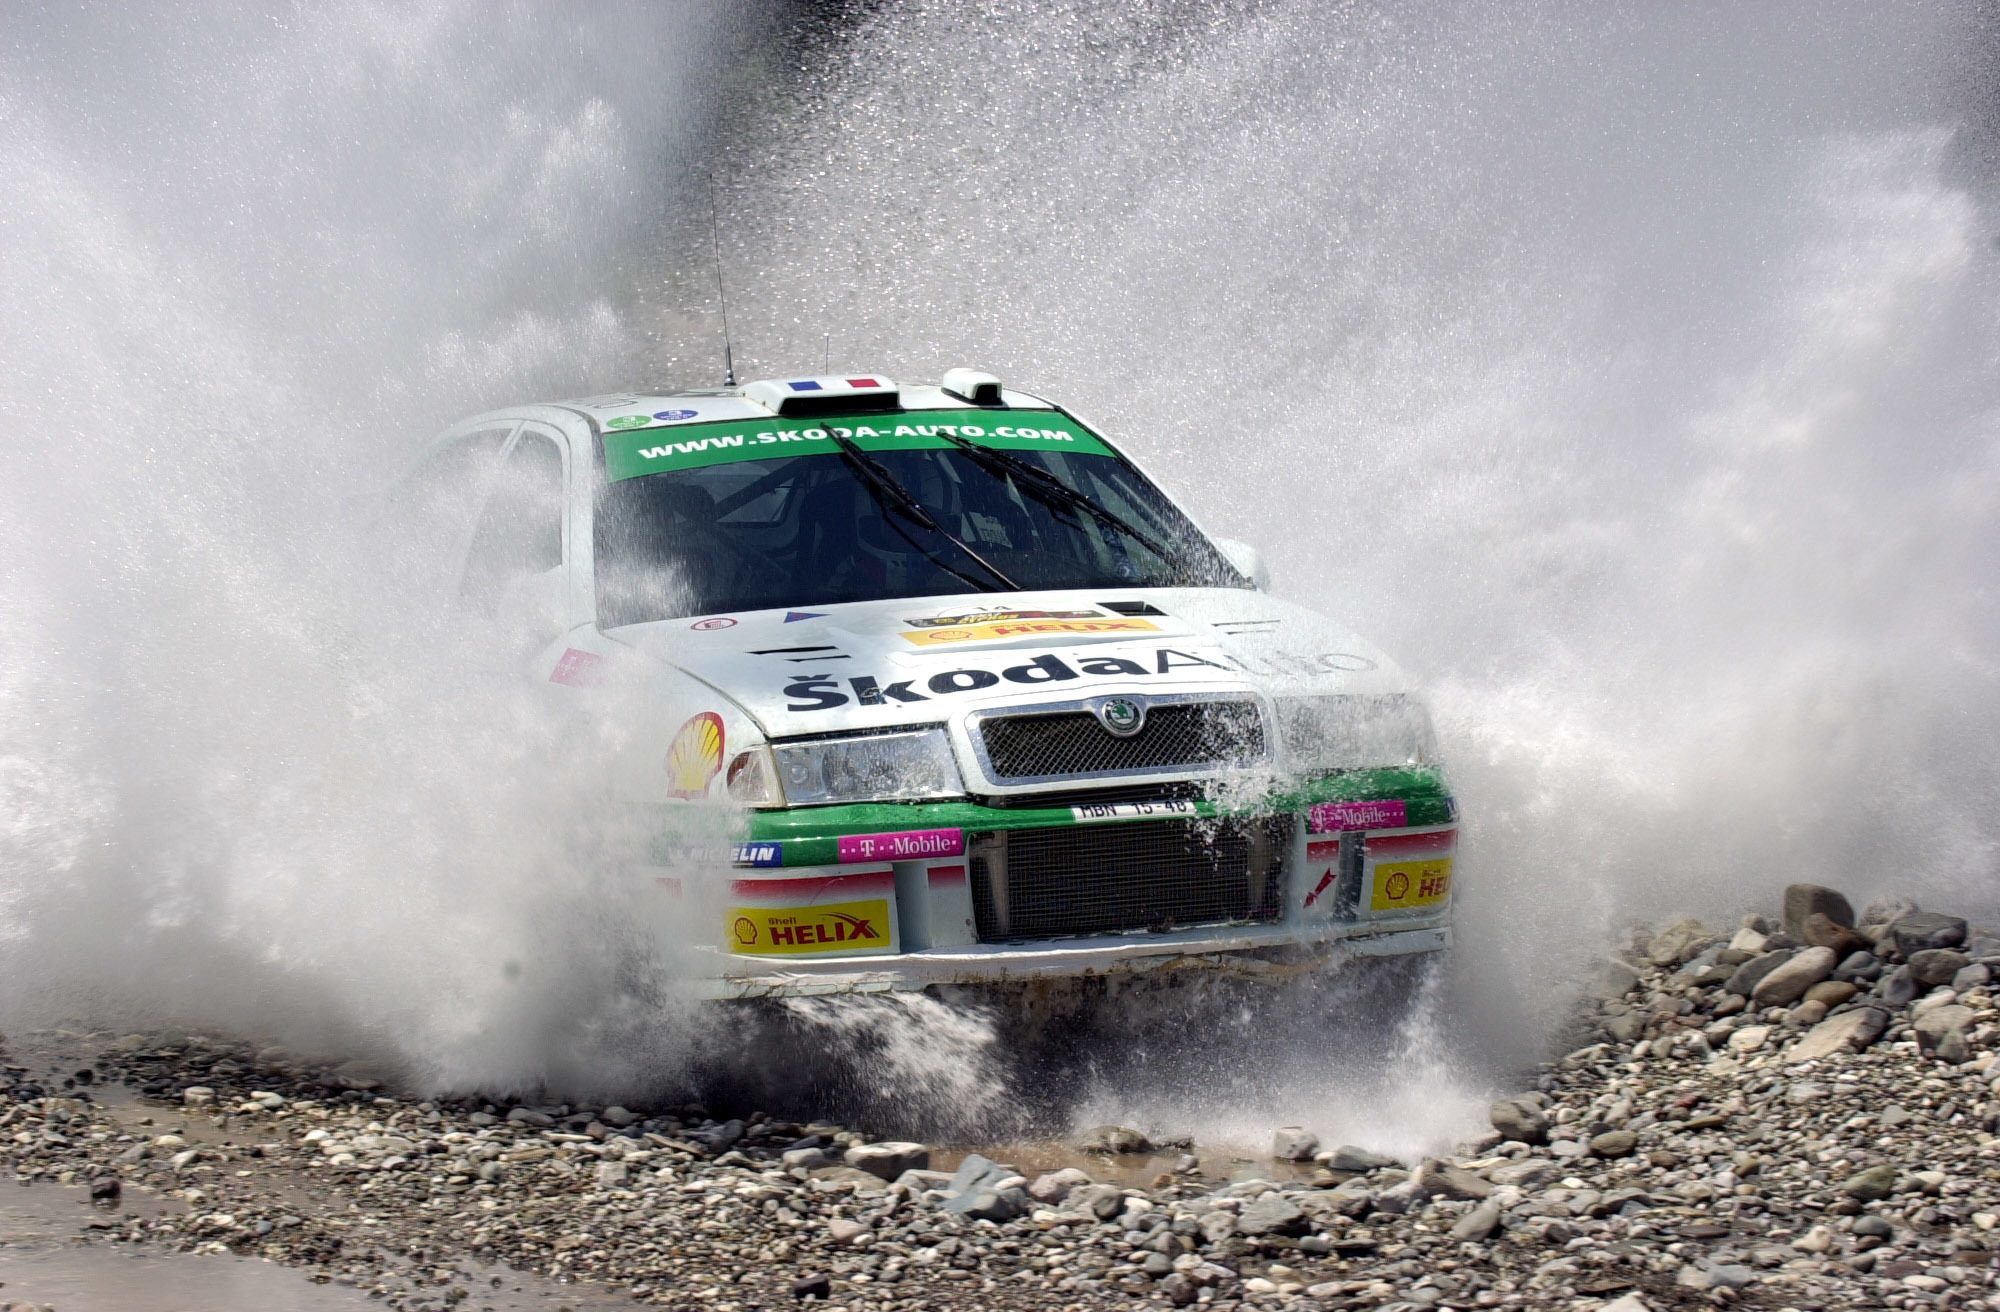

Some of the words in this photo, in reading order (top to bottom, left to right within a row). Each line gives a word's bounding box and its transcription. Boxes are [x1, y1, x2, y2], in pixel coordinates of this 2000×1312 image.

[638, 425, 1074, 459] WWW.SKODA-AUTO.COM
[991, 621, 1147, 635] HELIX
[1080, 804, 1117, 819] MBN
[769, 914, 879, 946] HELIX
